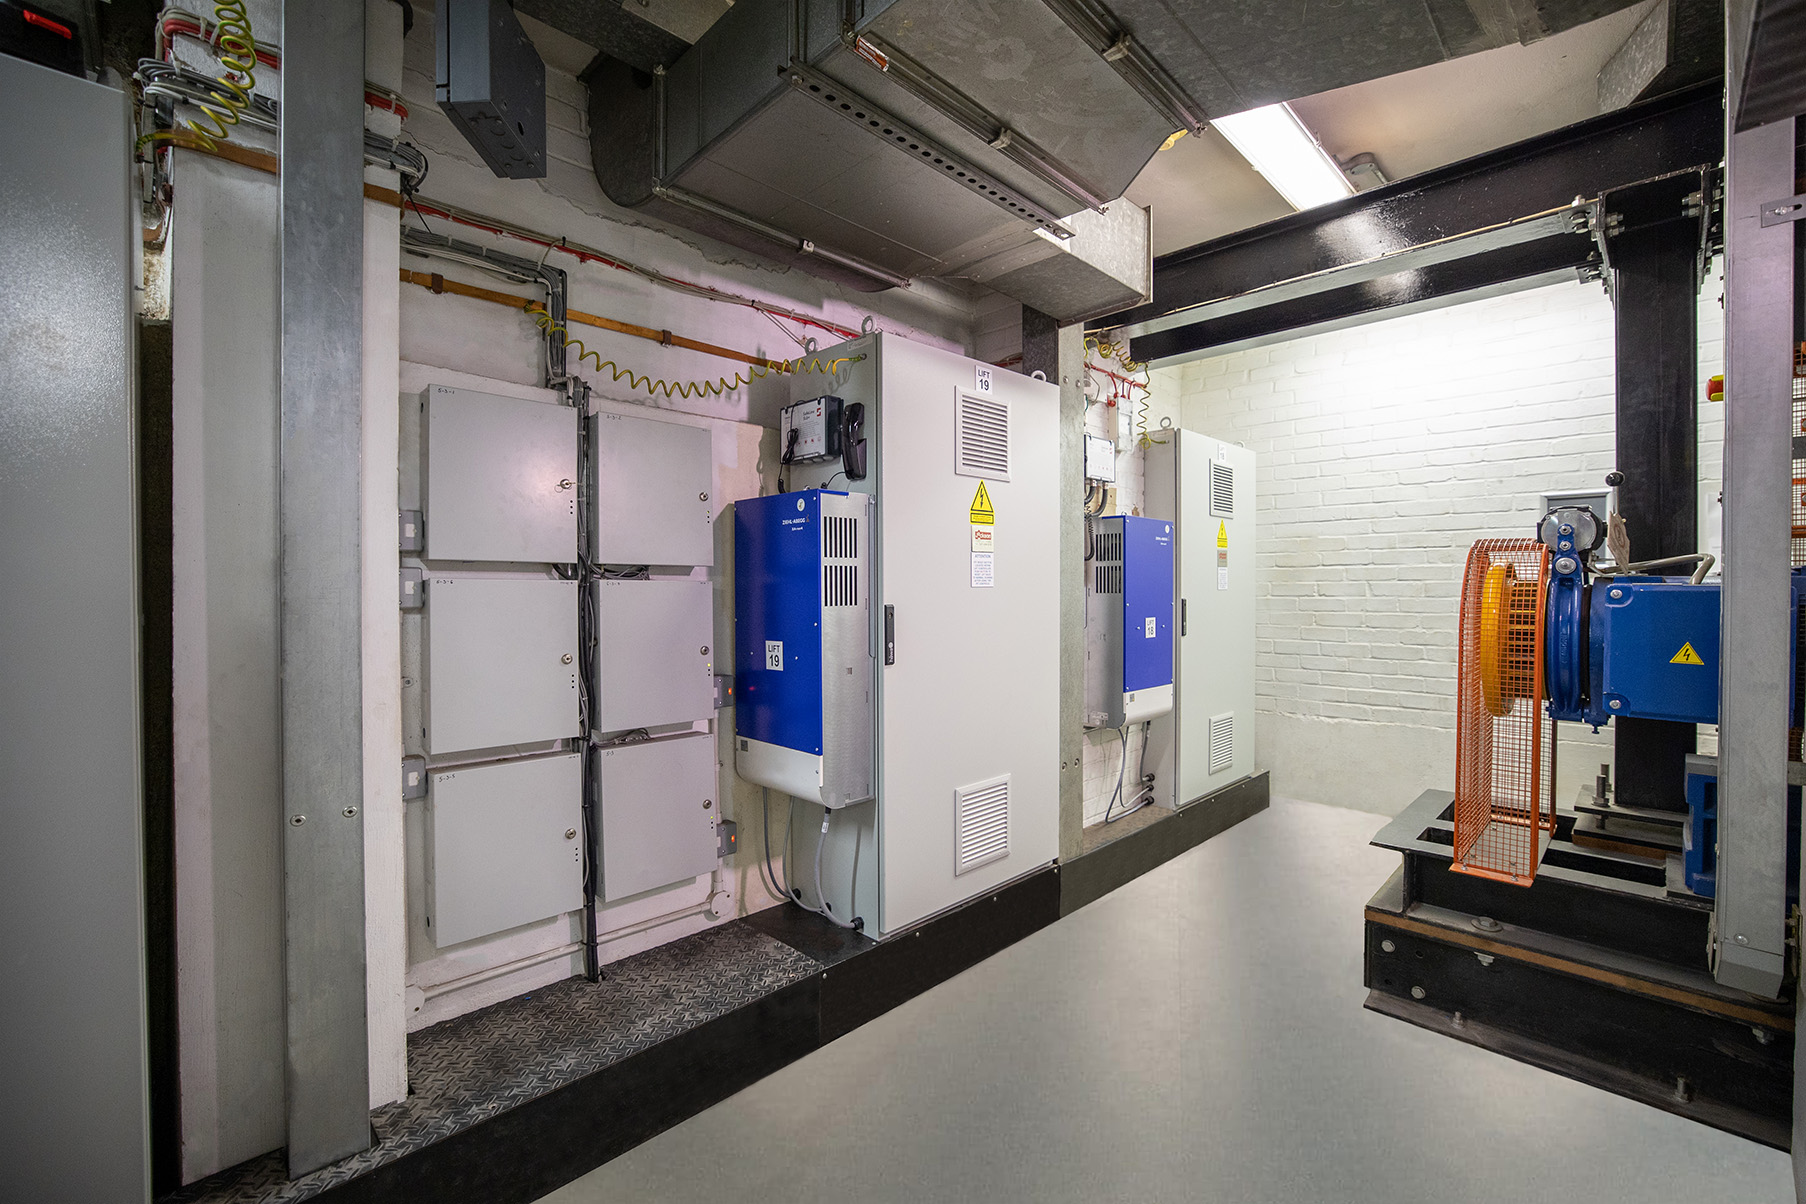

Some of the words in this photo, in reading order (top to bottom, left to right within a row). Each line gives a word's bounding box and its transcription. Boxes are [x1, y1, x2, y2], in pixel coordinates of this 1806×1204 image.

[978, 369, 990, 379] LIFT
[979, 378, 990, 391] 19
[768, 644, 780, 653] LIFT
[769, 654, 780, 667] 19
